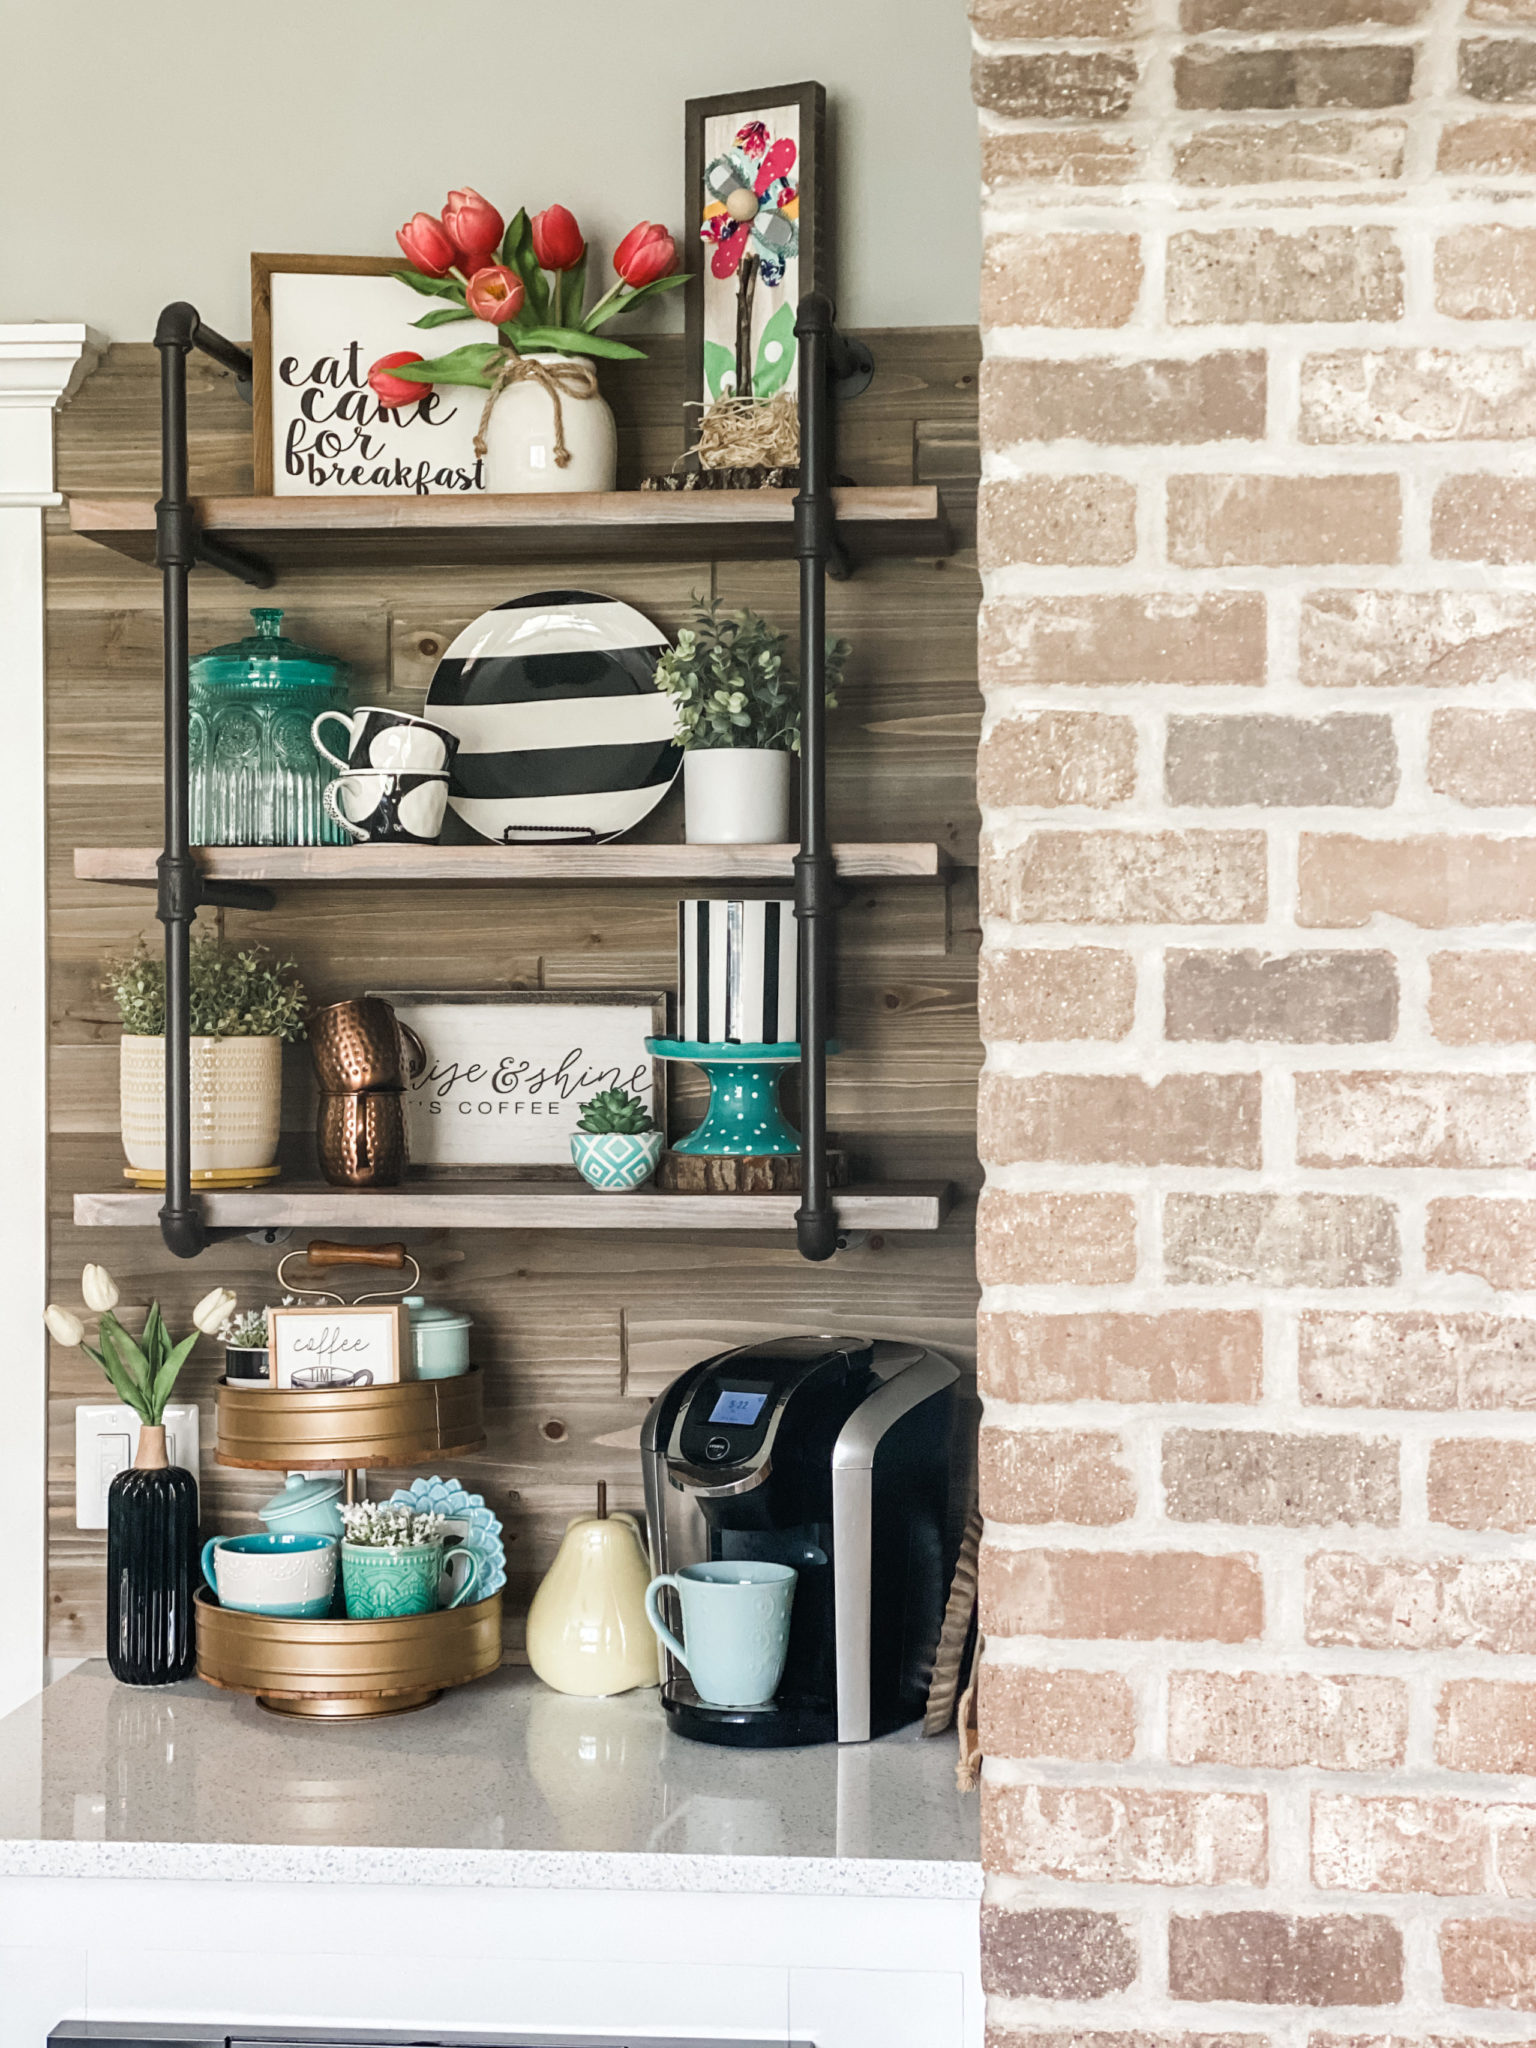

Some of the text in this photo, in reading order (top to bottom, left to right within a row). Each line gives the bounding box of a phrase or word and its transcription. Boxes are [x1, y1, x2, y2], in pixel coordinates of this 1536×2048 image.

[279, 341, 368, 388] eat
[285, 418, 386, 475] for
[308, 453, 486, 495] breakfast
[458, 1101, 560, 1115] COFFEE
[293, 1327, 370, 1362] coffee
